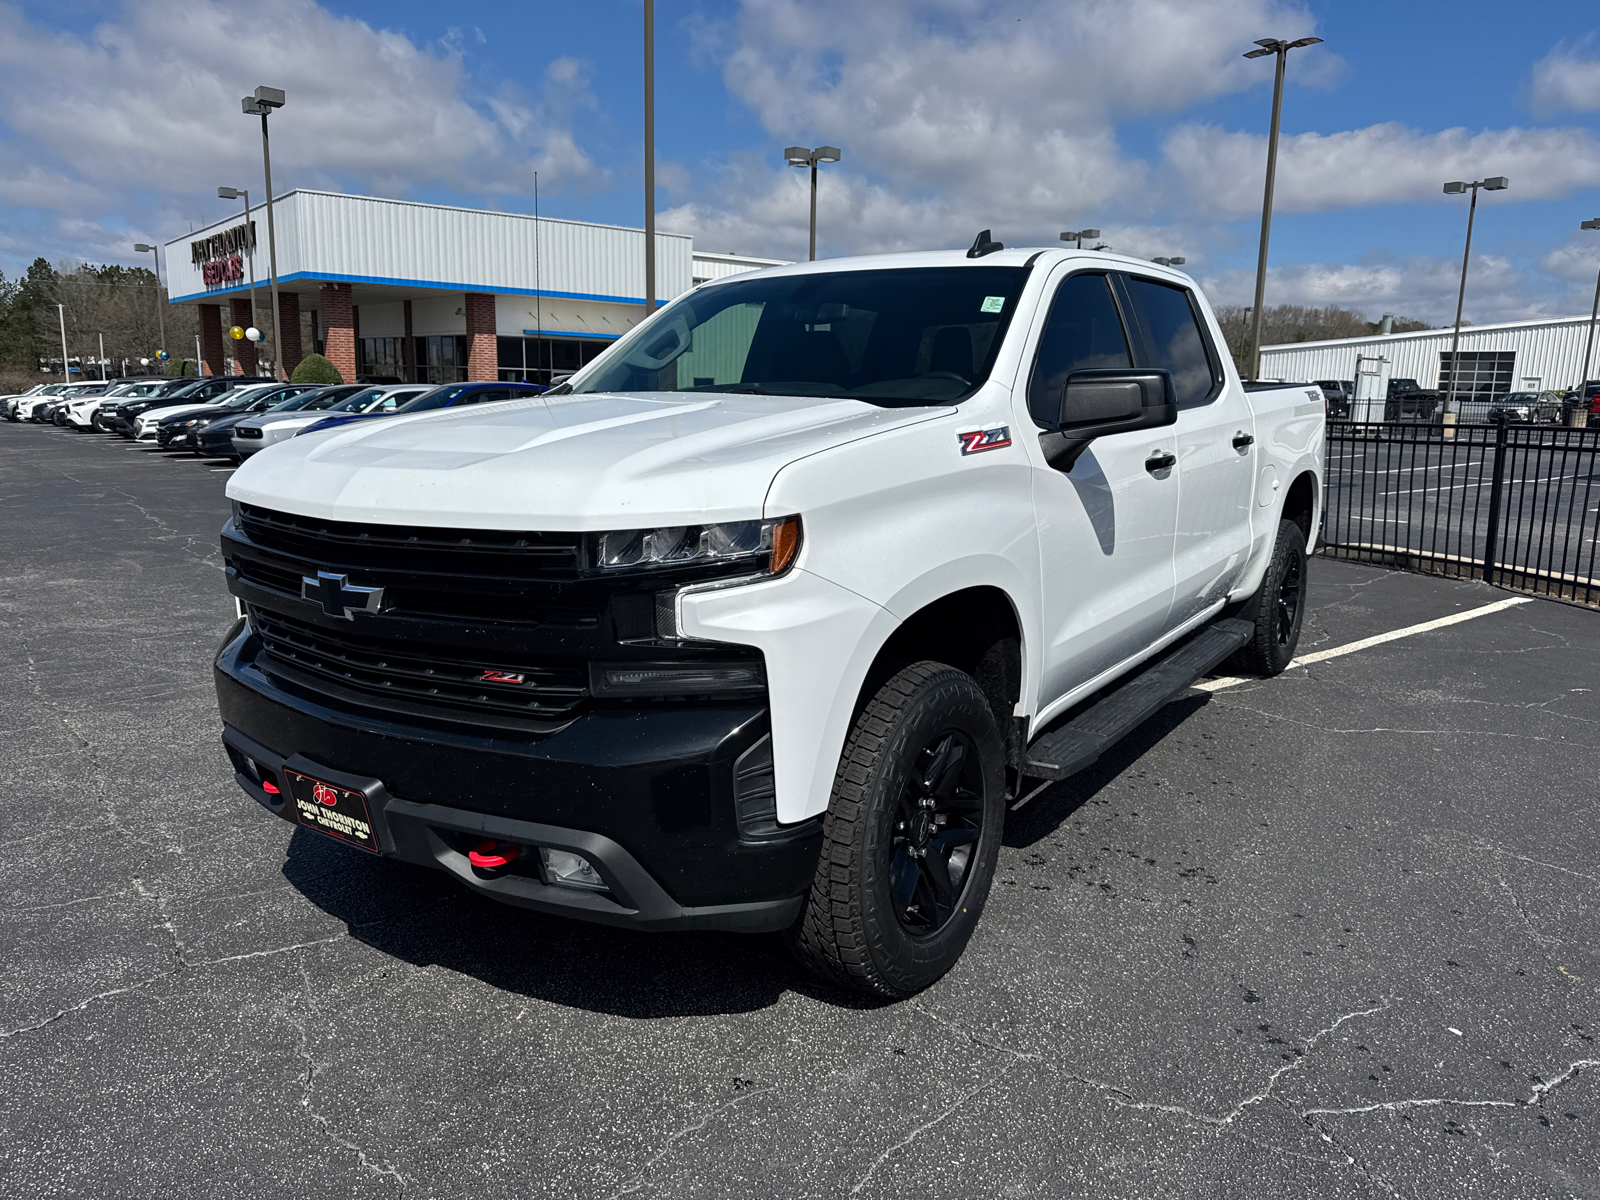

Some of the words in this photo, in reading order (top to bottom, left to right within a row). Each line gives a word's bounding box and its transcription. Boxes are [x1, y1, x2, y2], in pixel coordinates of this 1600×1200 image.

[202, 260, 221, 285] USED
[220, 254, 243, 281] CARS
[956, 426, 1012, 456] Z71
[480, 670, 525, 684] Z71
[296, 798, 321, 816] JOHN
[319, 806, 371, 835] THORNTON
[316, 815, 353, 836] CHEVROLET
